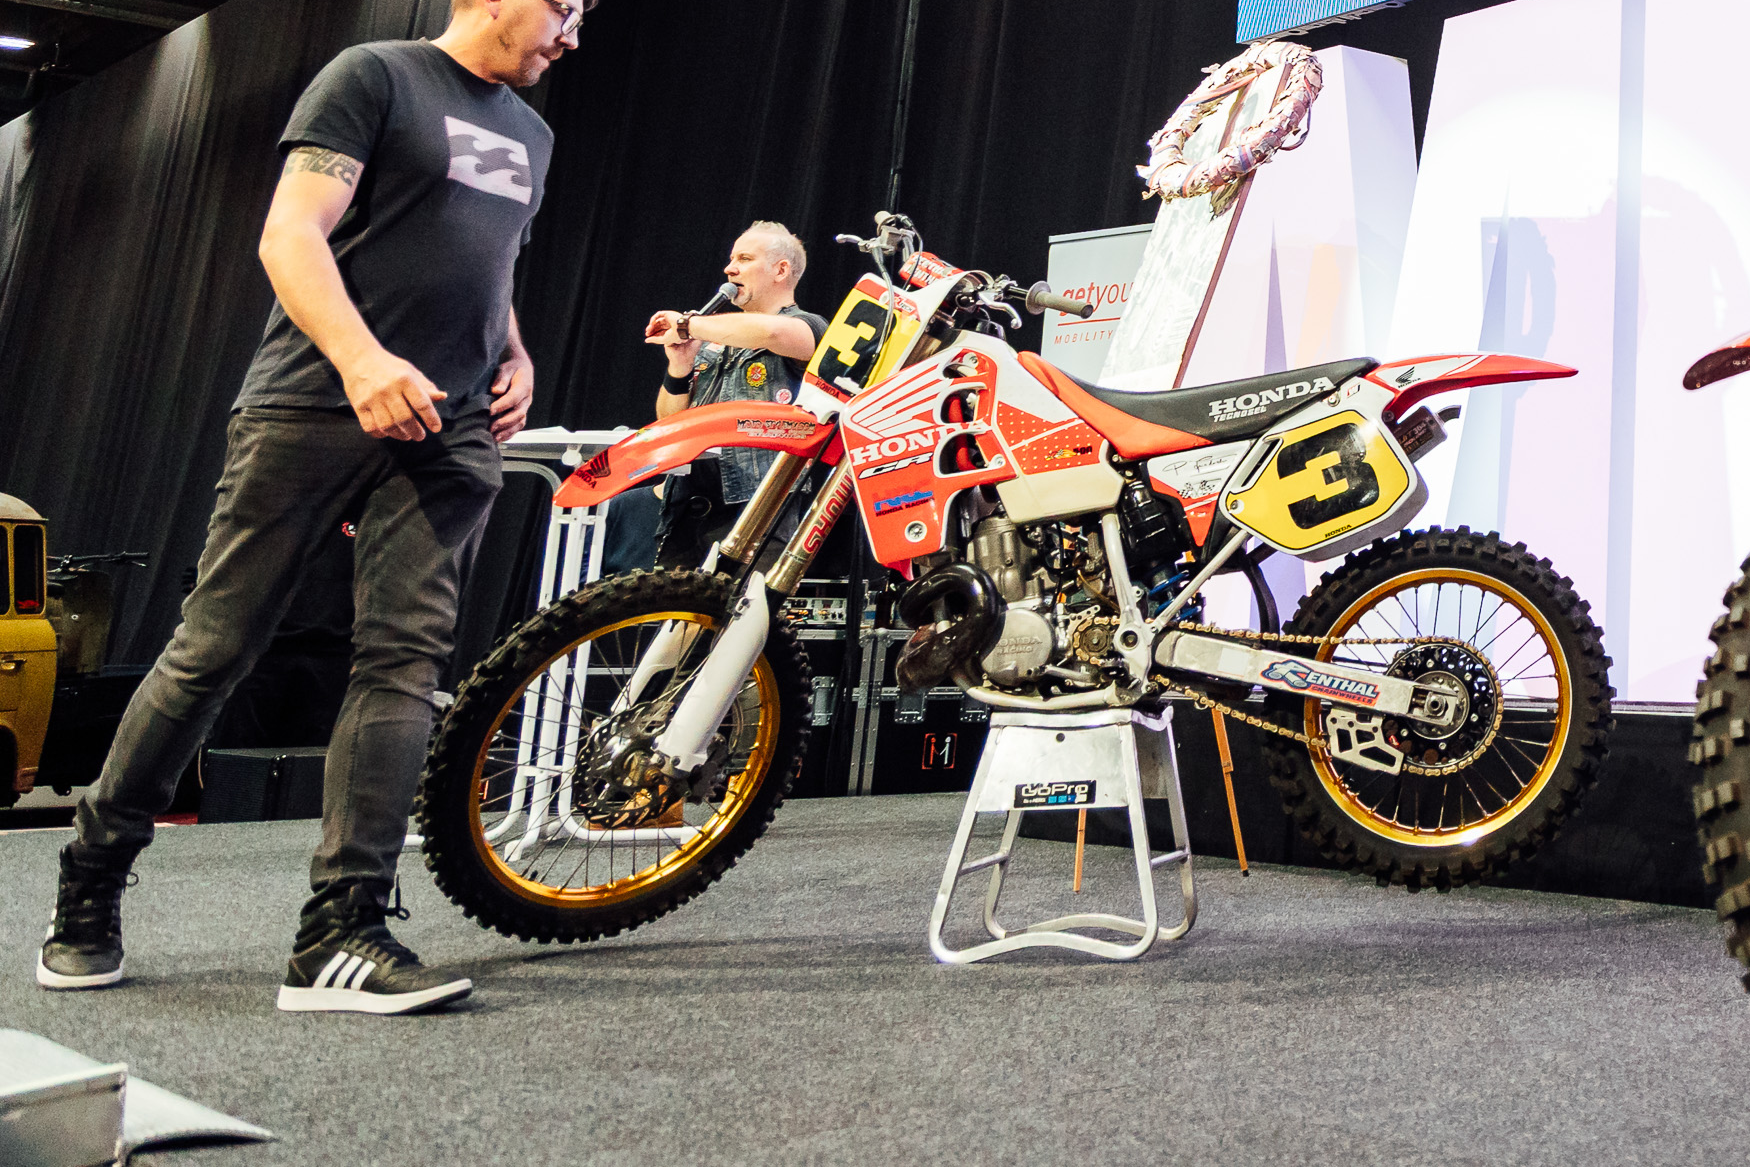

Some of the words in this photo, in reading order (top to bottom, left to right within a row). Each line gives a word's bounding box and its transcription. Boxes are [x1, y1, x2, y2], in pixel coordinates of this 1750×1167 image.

[817, 297, 898, 385] 3
[1054, 330, 1114, 345] MOBILITY
[815, 380, 840, 399] HONDA
[1208, 376, 1337, 417] HONDA
[1213, 406, 1267, 423] TECNOSEL
[1277, 423, 1381, 530] 3
[803, 474, 854, 554] SHOW
[875, 506, 903, 518] HONDA
[1324, 524, 1352, 538] HONDA
